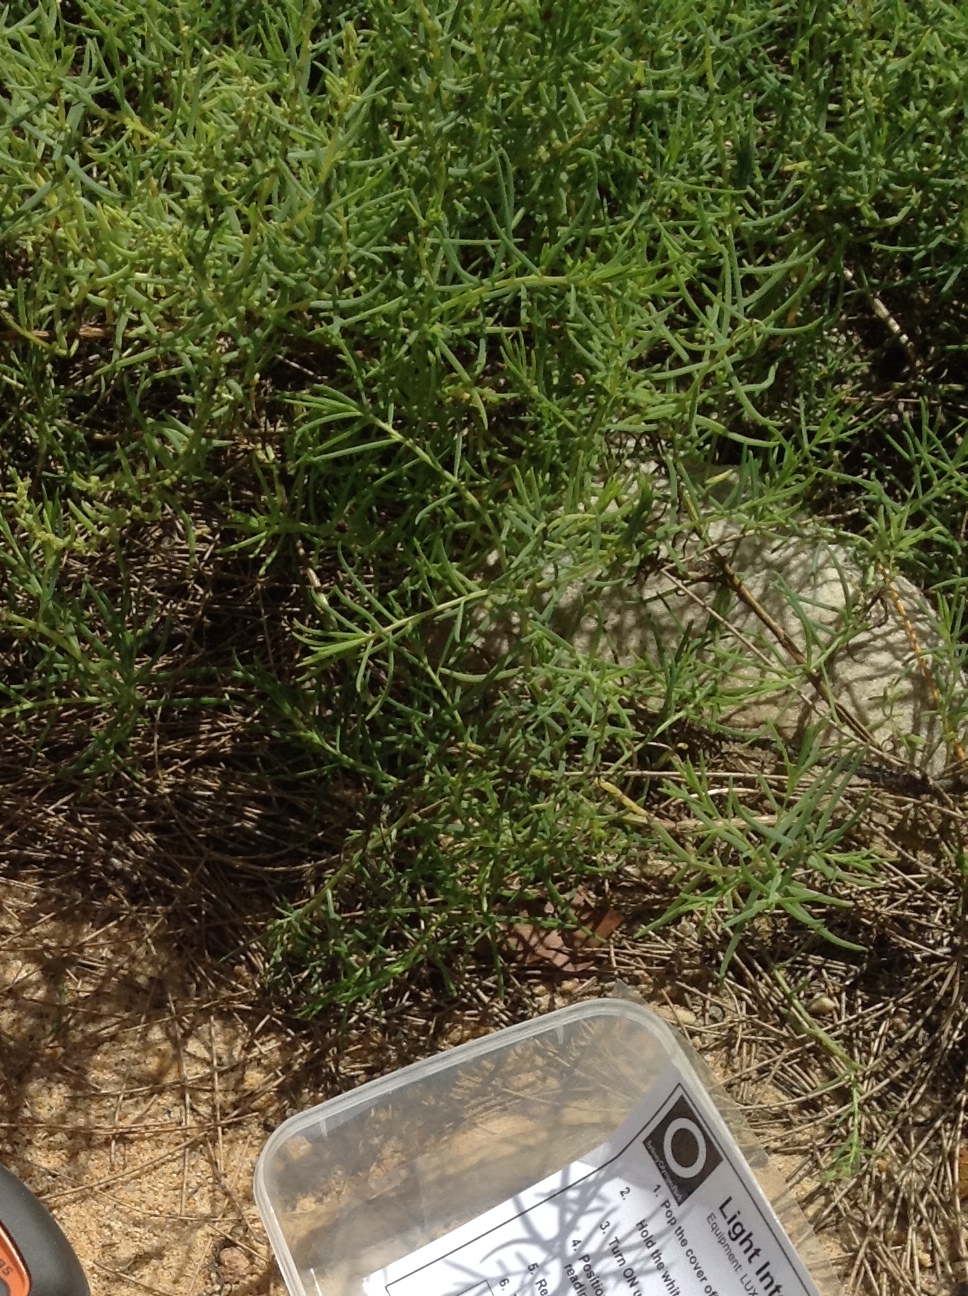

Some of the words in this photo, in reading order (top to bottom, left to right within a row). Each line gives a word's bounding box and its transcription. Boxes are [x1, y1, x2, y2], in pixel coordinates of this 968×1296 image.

[596, 1219, 614, 1235] 3.
[617, 1185, 633, 1201] 2.
[634, 1218, 657, 1250] Hold
[648, 1248, 666, 1271] the
[650, 1183, 664, 1198] 1.
[658, 1198, 678, 1227] Pop
[673, 1225, 689, 1248] the
[684, 1247, 708, 1283] cover
[715, 1194, 763, 1265] Light
[569, 1237, 584, 1252] 4.
[604, 1235, 628, 1267] Turn
[704, 1211, 744, 1274] Equipment:
[525, 1261, 541, 1276] 5.
[621, 1266, 640, 1289] ON
[496, 1276, 512, 1291] 6.
